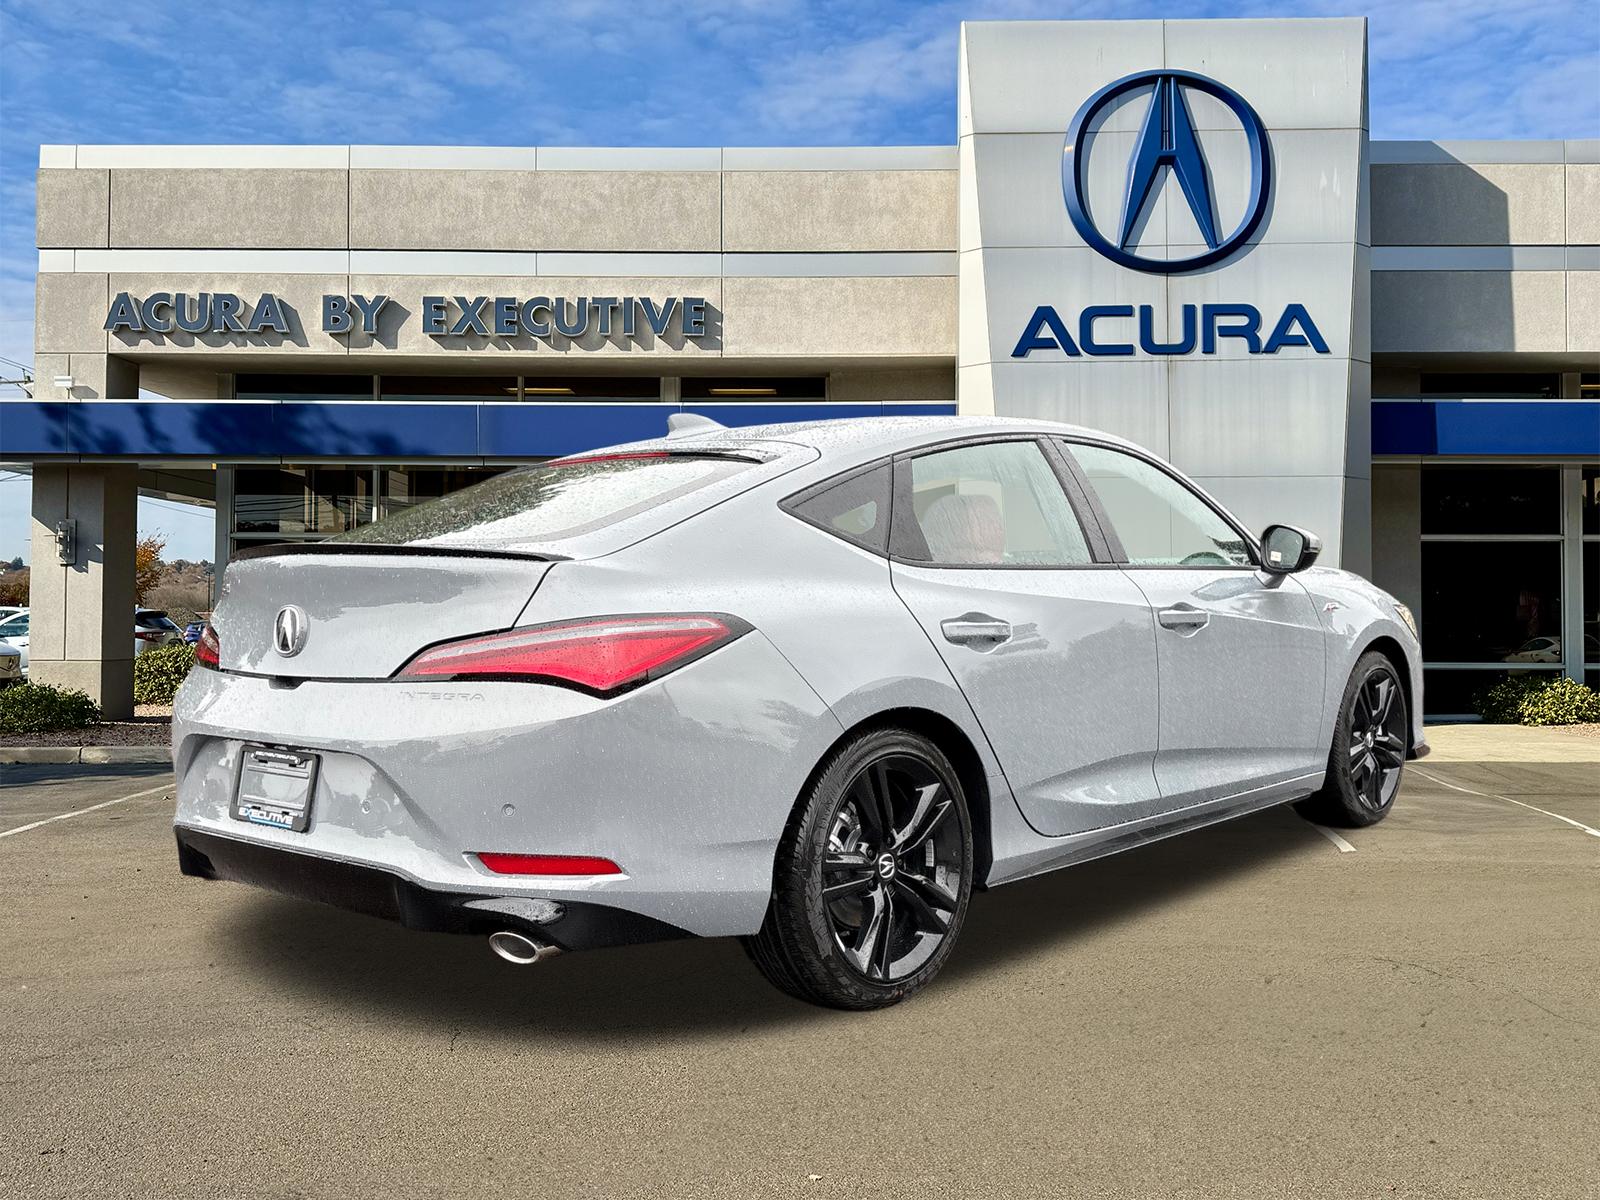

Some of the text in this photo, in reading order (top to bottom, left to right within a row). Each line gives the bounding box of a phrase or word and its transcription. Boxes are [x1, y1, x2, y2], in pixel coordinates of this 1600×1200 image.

[103, 292, 706, 337] ACURA BY EXECUTIVE
[1011, 303, 1331, 357] ACURA
[238, 806, 294, 825] EXECUTIVE
